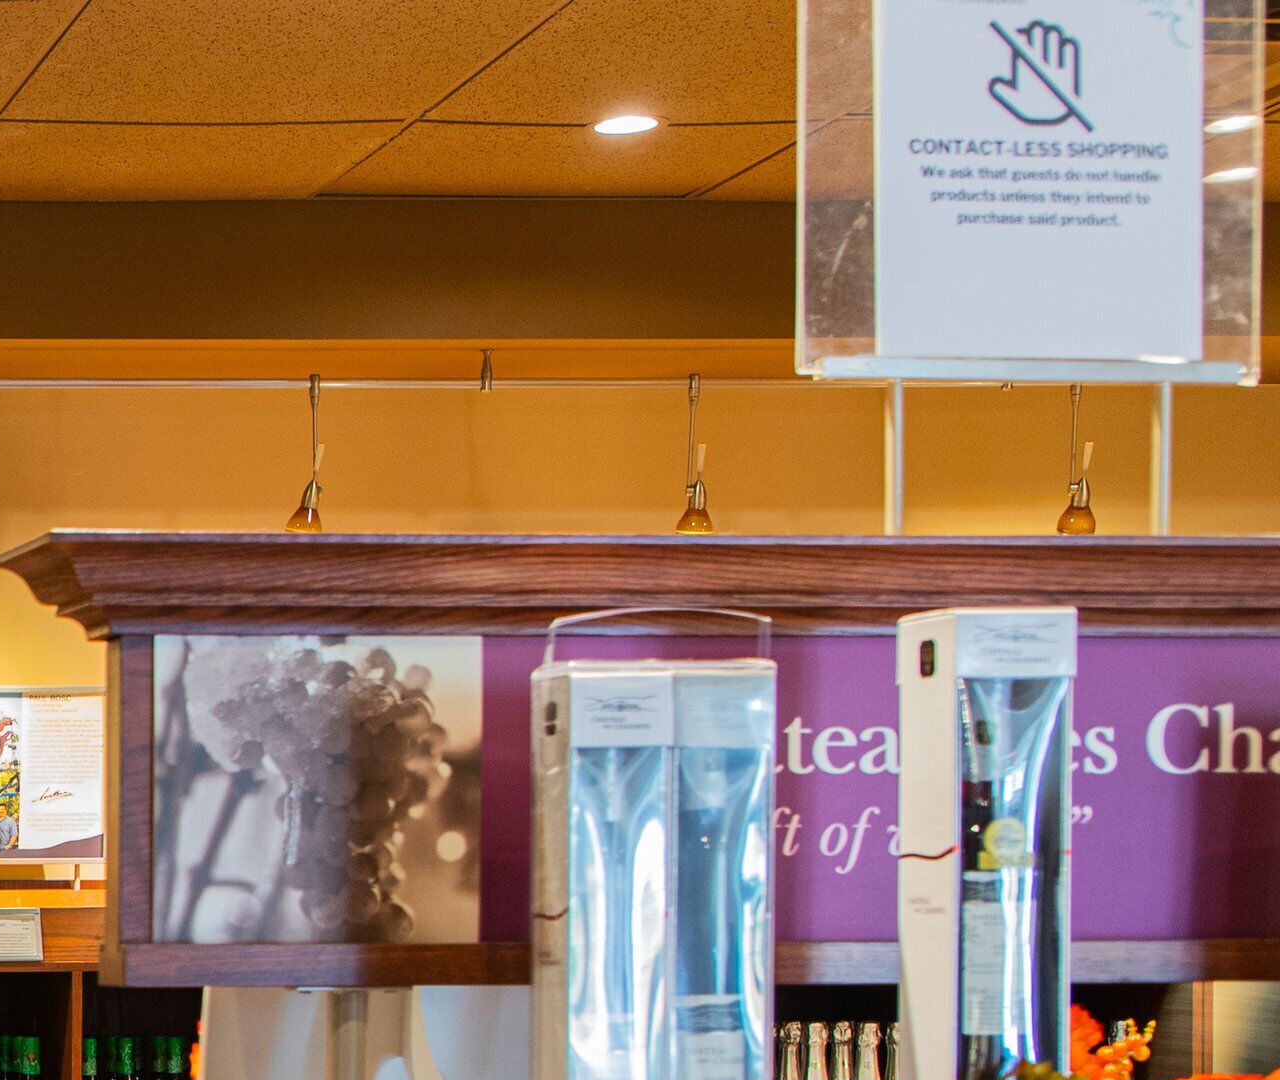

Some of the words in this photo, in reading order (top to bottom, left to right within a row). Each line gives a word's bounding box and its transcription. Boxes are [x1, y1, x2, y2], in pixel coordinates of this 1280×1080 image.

[908, 138, 1062, 158] CONTACT-LESS
[1067, 141, 1169, 160] SHOPPING
[921, 165, 946, 180] We
[949, 167, 974, 181] ask
[978, 167, 1007, 181] that
[1011, 168, 1062, 184] guests
[1113, 168, 1161, 184] handle
[931, 188, 997, 205] products
[1000, 189, 1047, 203] unless
[1049, 189, 1081, 206] they
[1085, 190, 1131, 205] intend
[956, 211, 1024, 227] purchase
[1028, 211, 1057, 226] said
[1061, 212, 1122, 228] product.
[819, 805, 881, 875] of
